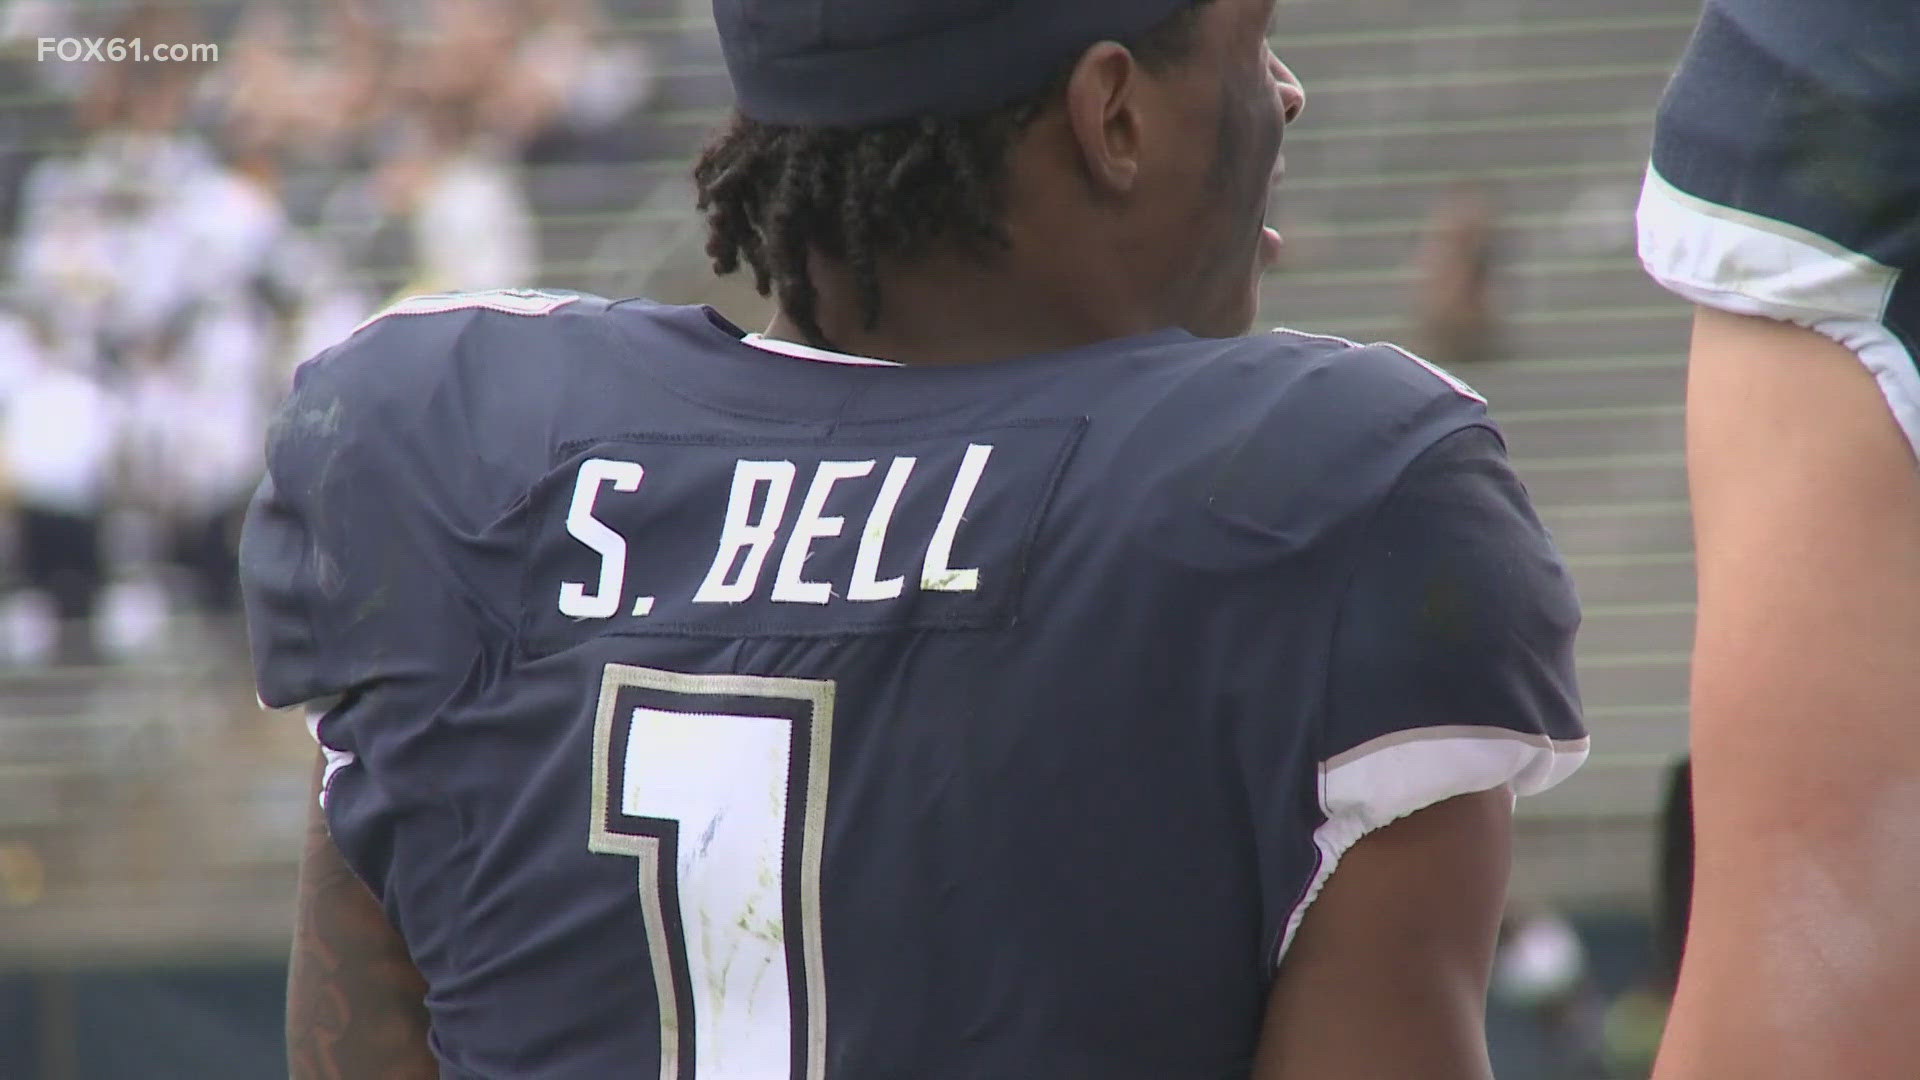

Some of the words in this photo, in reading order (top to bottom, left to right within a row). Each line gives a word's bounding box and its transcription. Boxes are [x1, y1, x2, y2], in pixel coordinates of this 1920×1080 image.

[558, 458, 655, 618] S.
[692, 443, 994, 605] BELL
[588, 663, 835, 1080] 1
